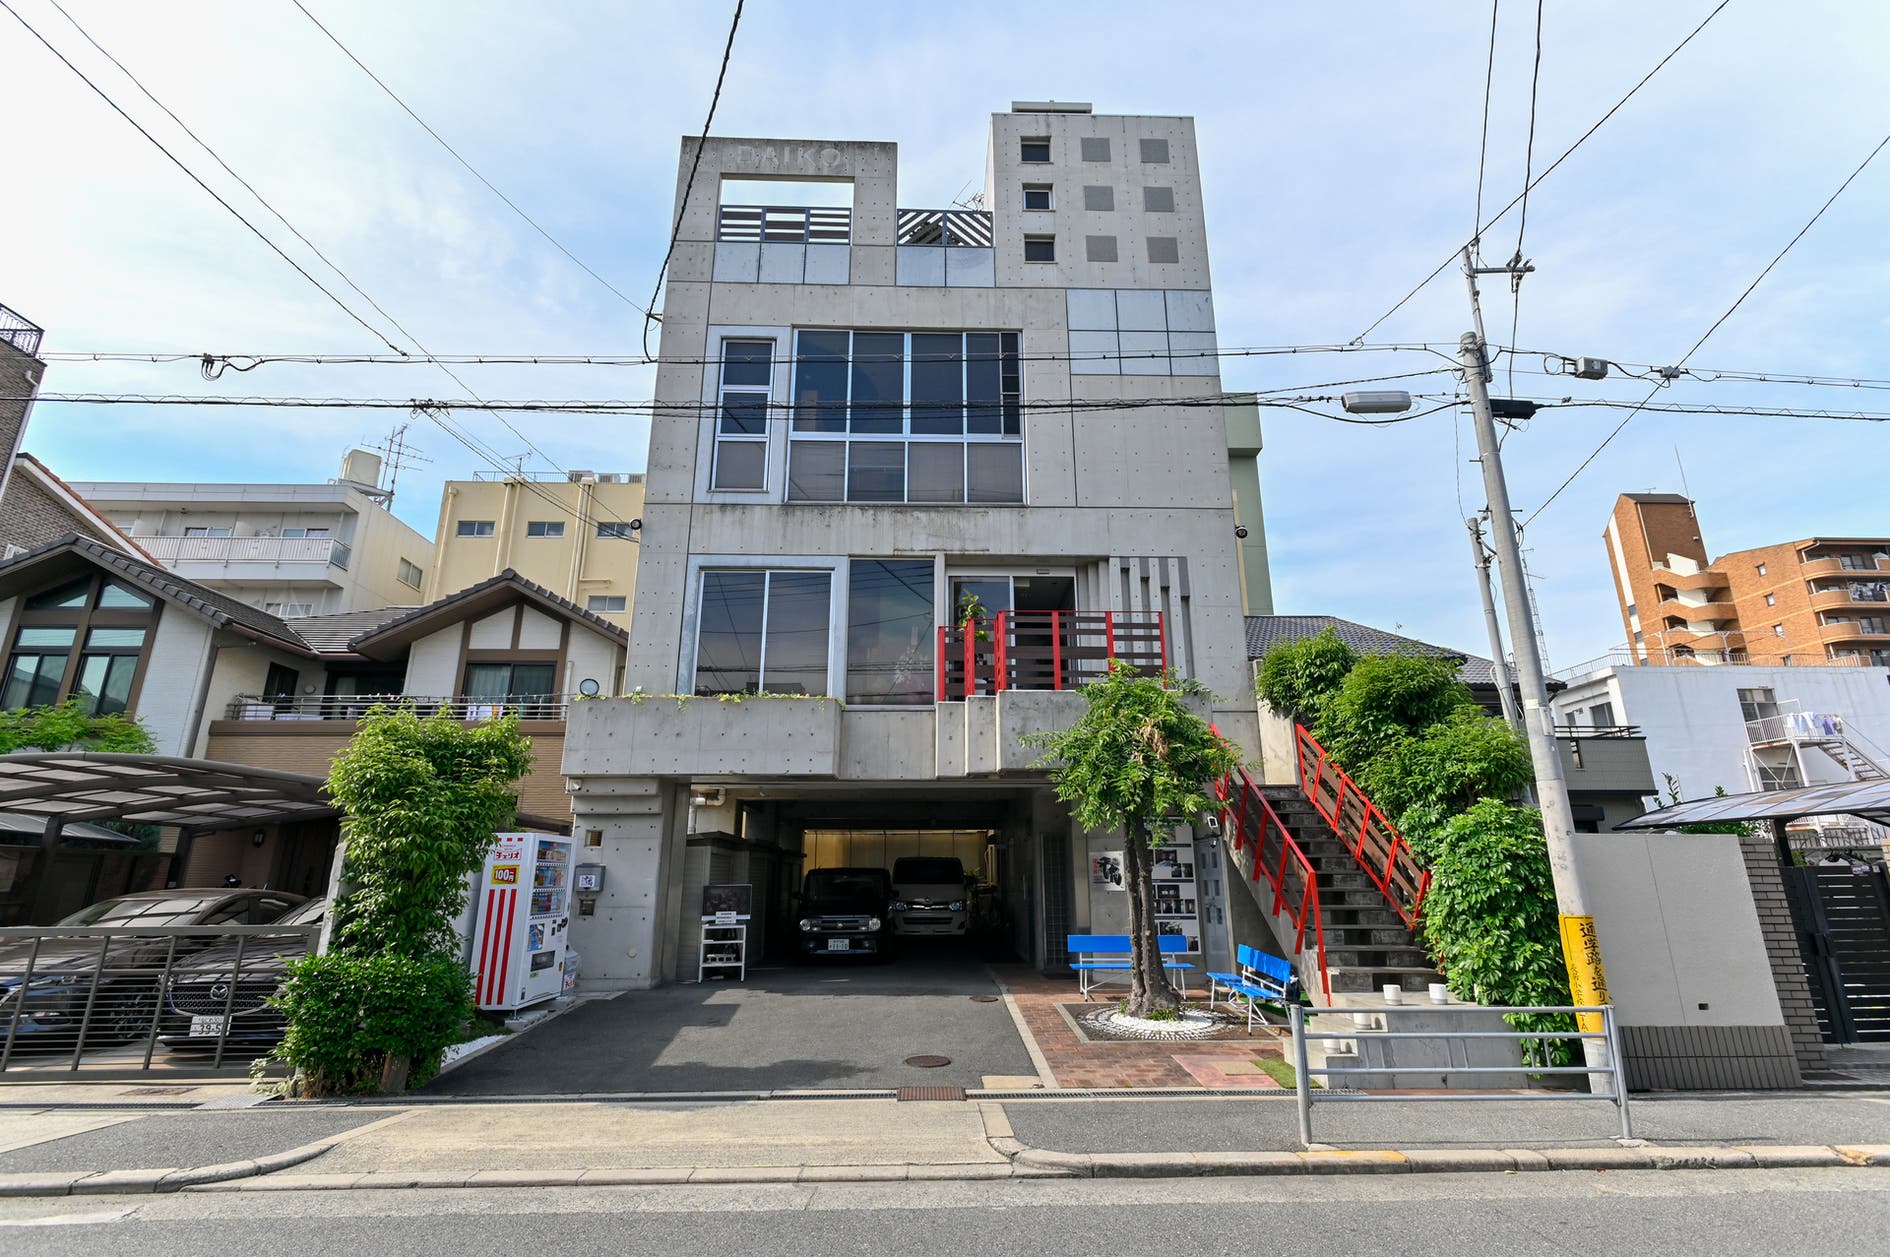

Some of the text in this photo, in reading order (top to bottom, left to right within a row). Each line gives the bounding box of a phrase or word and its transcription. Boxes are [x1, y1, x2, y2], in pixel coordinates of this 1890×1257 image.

[737, 145, 841, 168] DAIKO
[496, 850, 520, 859] チェリオ
